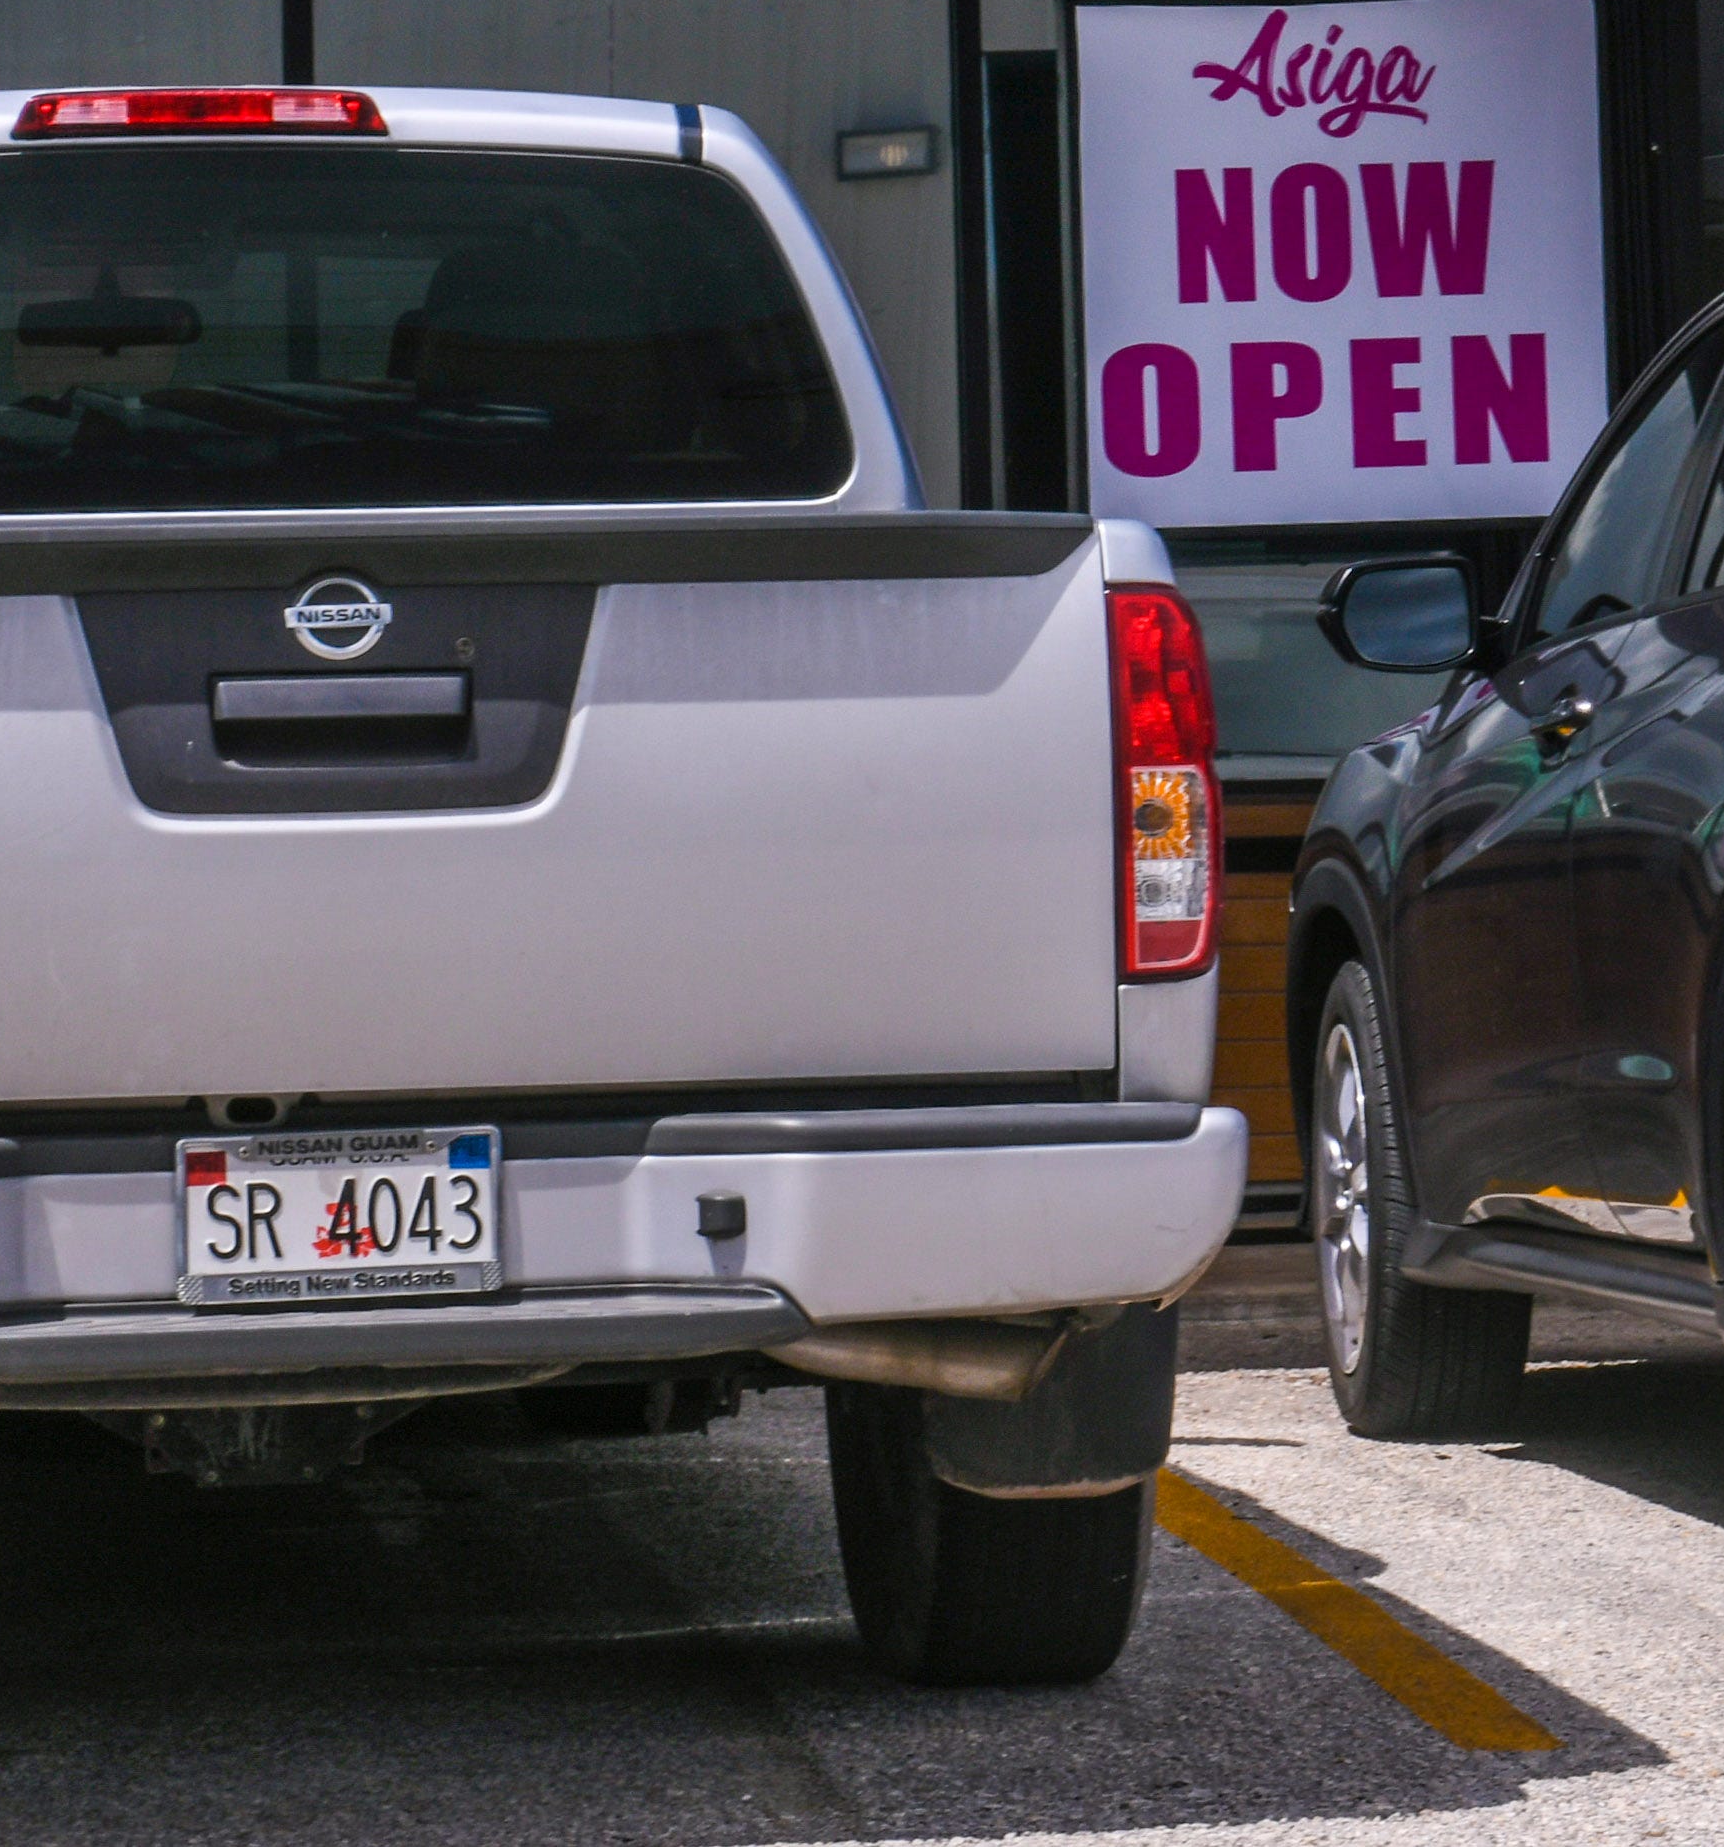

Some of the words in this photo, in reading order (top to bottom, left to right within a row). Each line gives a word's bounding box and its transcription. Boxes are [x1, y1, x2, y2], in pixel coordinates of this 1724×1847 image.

[1193, 9, 1436, 138] Asiga
[1174, 160, 1495, 304] NOW
[1101, 332, 1551, 477] OPEN
[297, 608, 381, 623] NISSAN
[257, 1138, 343, 1156] NISSAN
[349, 1134, 419, 1152] GUAM
[207, 1182, 283, 1260] SR
[329, 1174, 483, 1257] 4043
[228, 1278, 301, 1296] Setting
[307, 1275, 350, 1292] New
[354, 1269, 456, 1289] Standards
